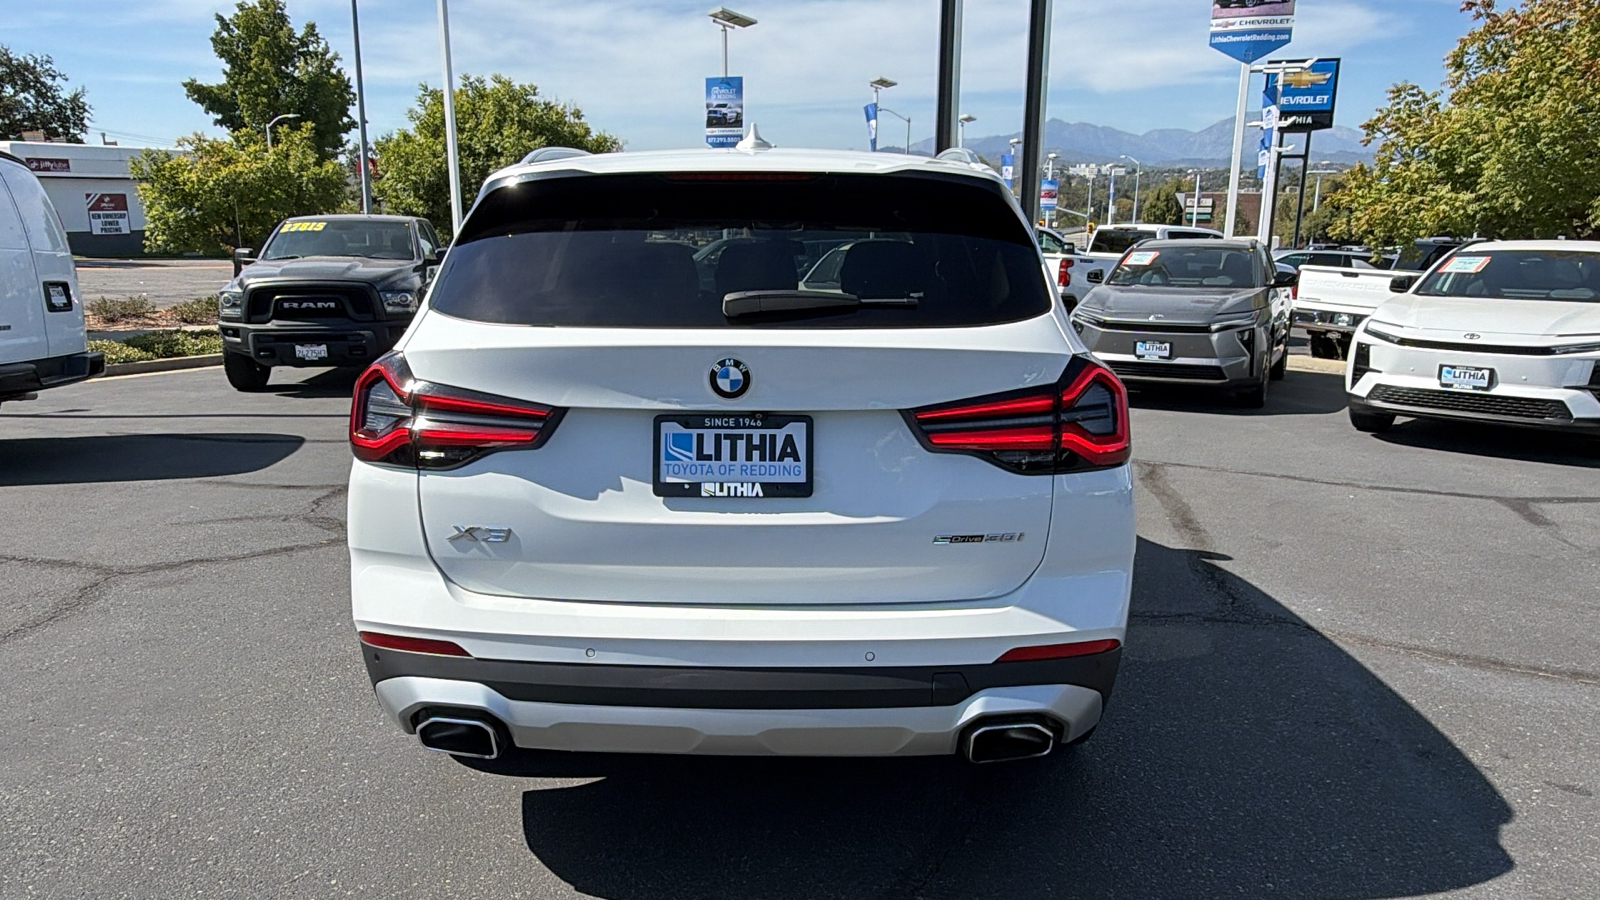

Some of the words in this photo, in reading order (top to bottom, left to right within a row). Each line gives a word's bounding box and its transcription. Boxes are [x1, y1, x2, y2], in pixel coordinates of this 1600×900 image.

[1239, 18, 1291, 26] CHEVROLET
[1211, 34, 1289, 43] LithiaChevroletRedding.com
[1280, 95, 1329, 105] EVROLET
[100, 226, 123, 234] PRICING
[1144, 344, 1168, 352] LITHIA
[714, 359, 747, 372] BMW
[1452, 370, 1487, 381] LITHIA
[704, 417, 735, 427] SINCE
[738, 418, 762, 427] 1946
[695, 432, 802, 463] LITHIA
[664, 464, 714, 476] TOYOTA
[718, 464, 735, 476] OF
[740, 465, 802, 476] REDDING
[716, 482, 763, 497] LITHIA
[446, 524, 512, 543] X3
